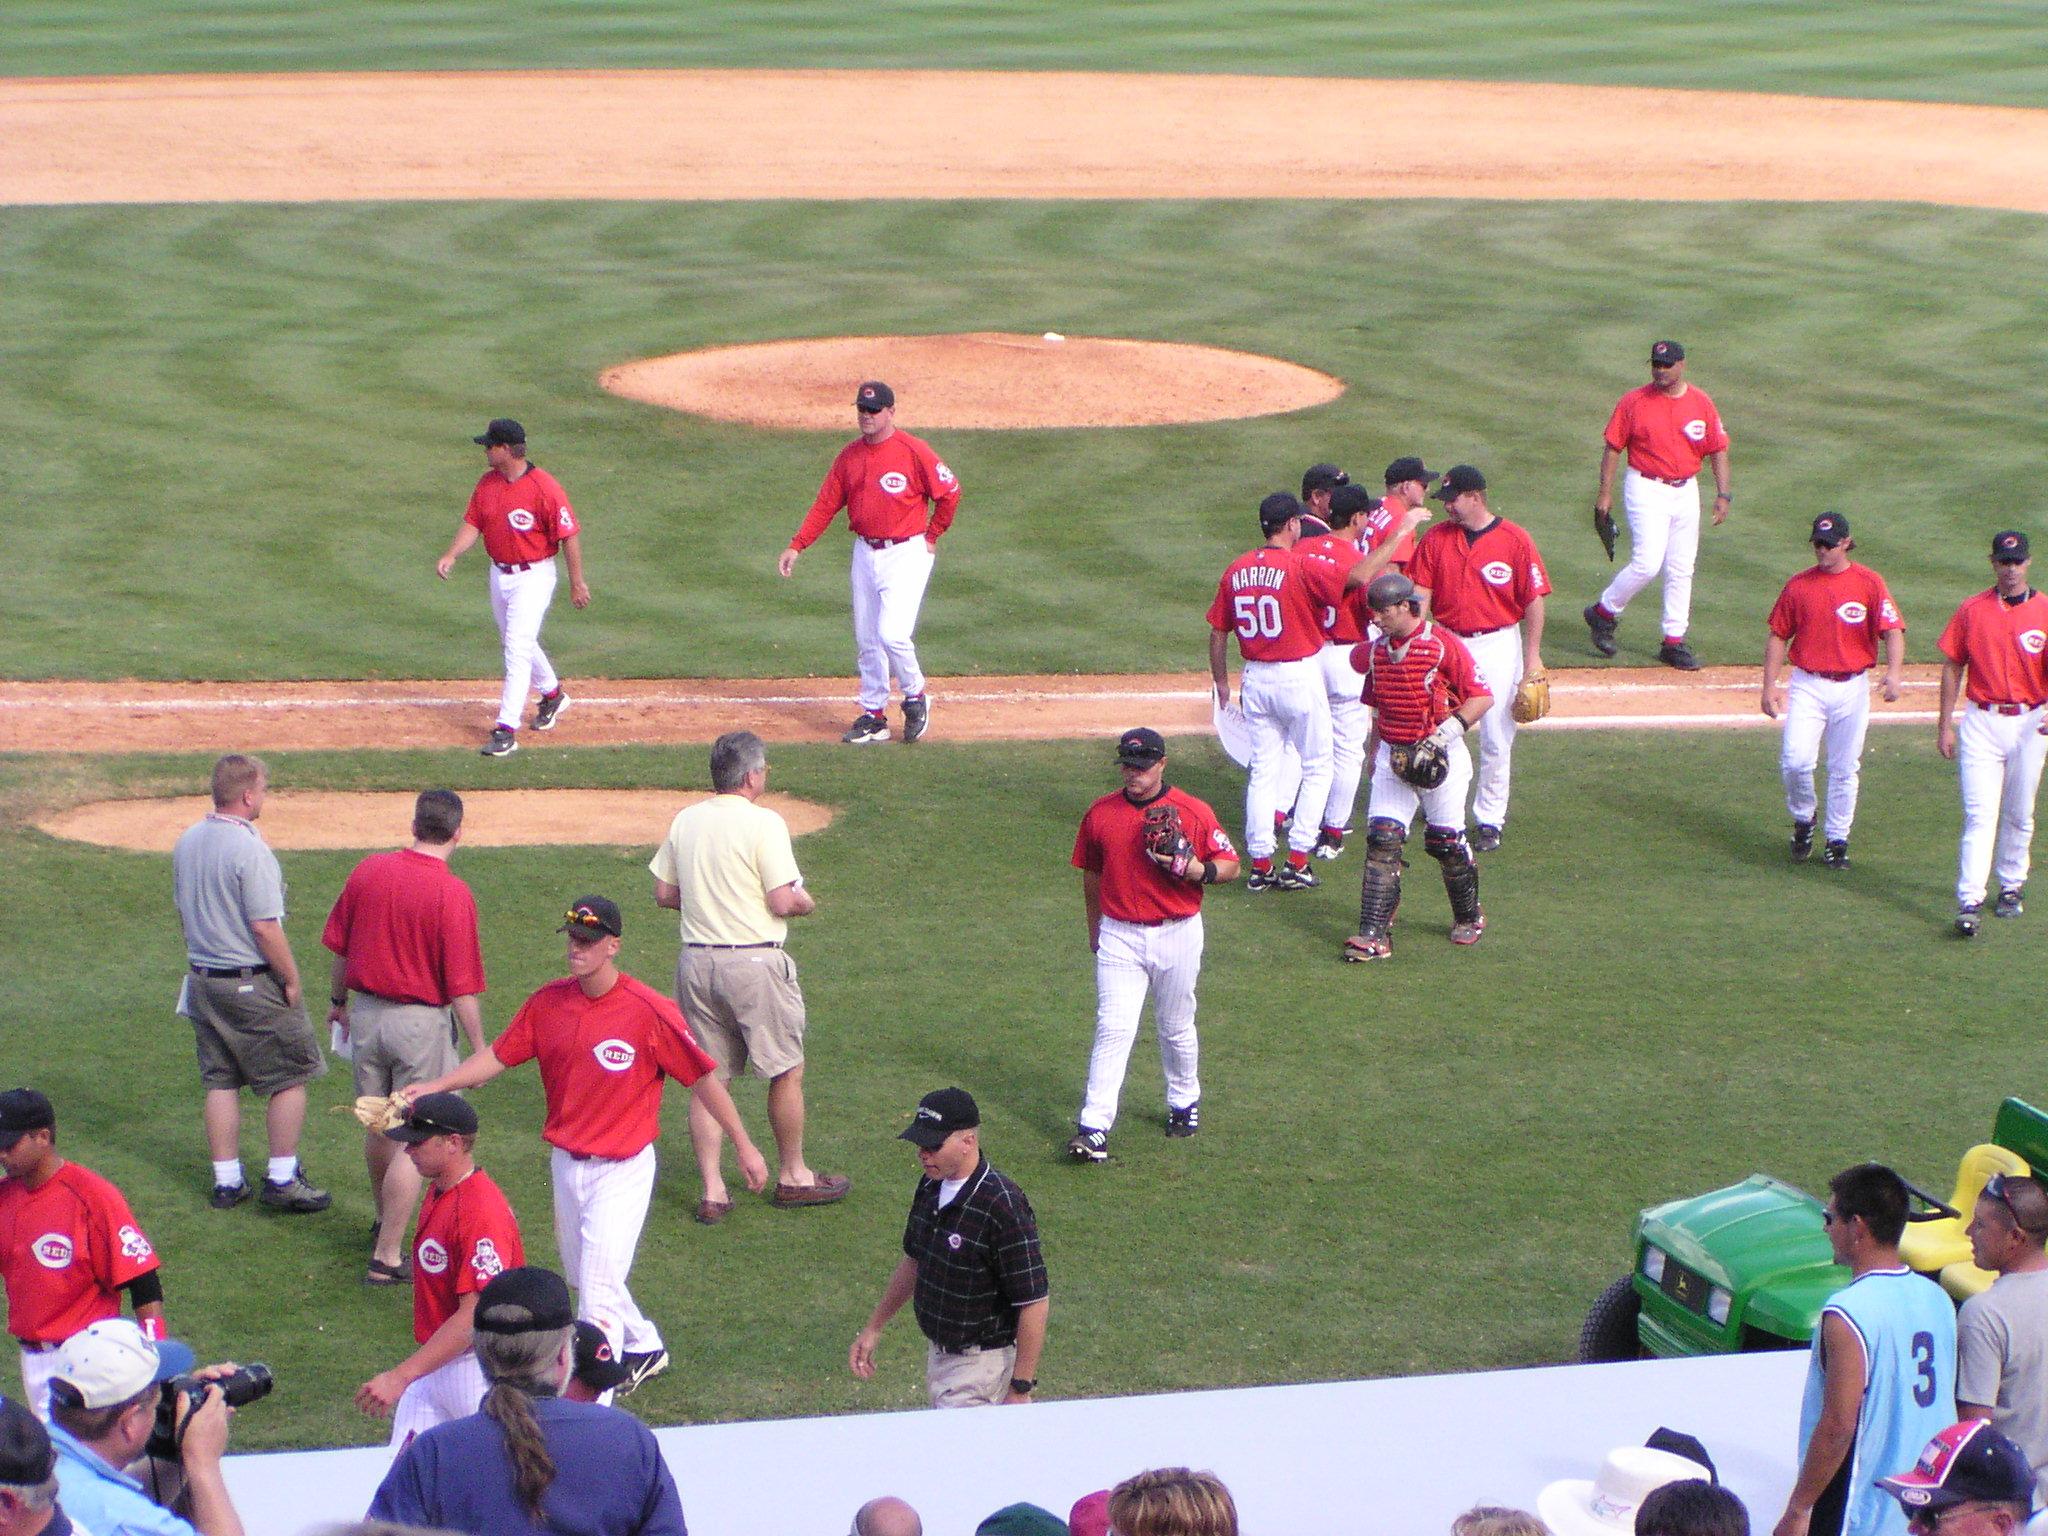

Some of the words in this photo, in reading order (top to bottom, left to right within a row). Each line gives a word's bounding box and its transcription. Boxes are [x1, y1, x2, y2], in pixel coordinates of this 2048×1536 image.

[1232, 566, 1285, 592] NARRON
[1234, 595, 1283, 638] 50
[1911, 1331, 1937, 1408] 3
